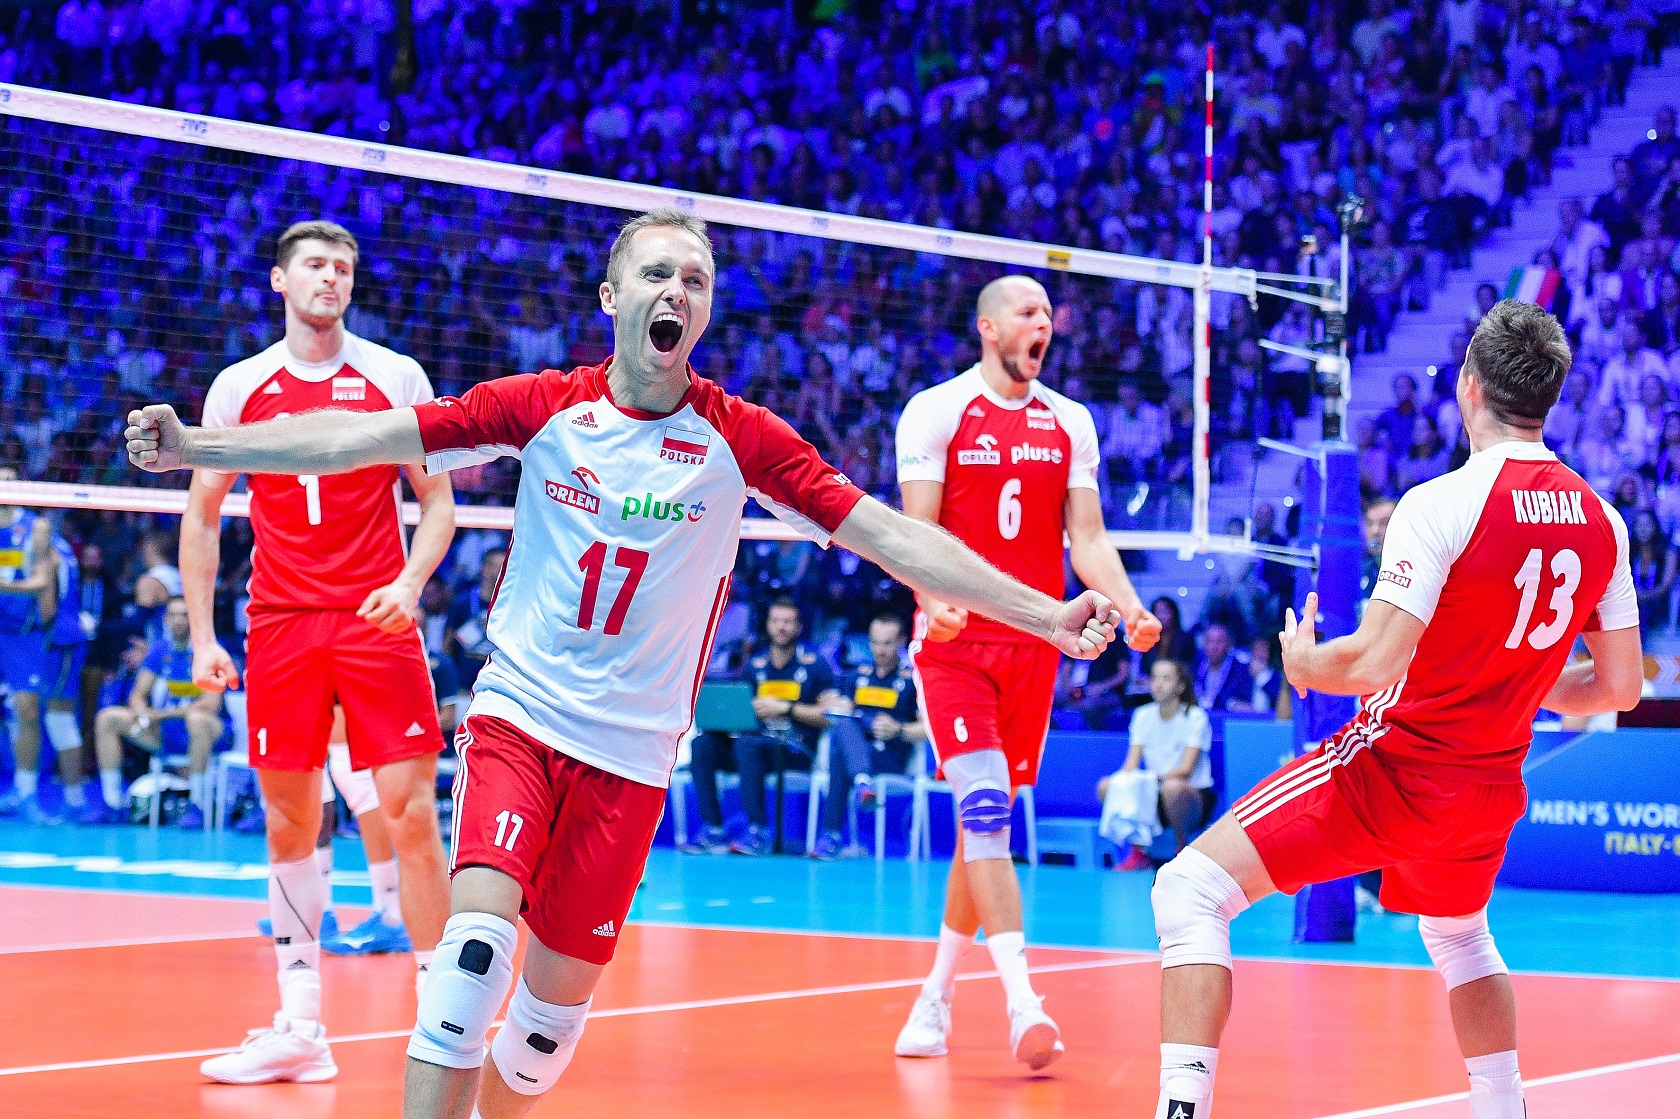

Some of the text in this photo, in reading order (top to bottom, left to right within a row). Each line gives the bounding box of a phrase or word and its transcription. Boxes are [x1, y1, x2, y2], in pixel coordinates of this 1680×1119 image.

[571, 418, 599, 429] adidas
[659, 449, 705, 466] POLSKA
[962, 454, 997, 464] ORLEN
[1010, 442, 1050, 465] plus
[297, 474, 322, 526] 1
[546, 483, 597, 513] ORLEN
[620, 492, 685, 522] plus
[997, 477, 1022, 541] 6
[1511, 489, 1588, 525] KUBIAK
[576, 540, 650, 636] 17
[1380, 570, 1409, 588] ORLEN
[1504, 548, 1582, 650] 13
[256, 727, 267, 756] 1
[953, 715, 969, 743] 6
[1529, 799, 1610, 827] MEN'S
[493, 809, 524, 852] 17
[592, 927, 616, 937] adidas
